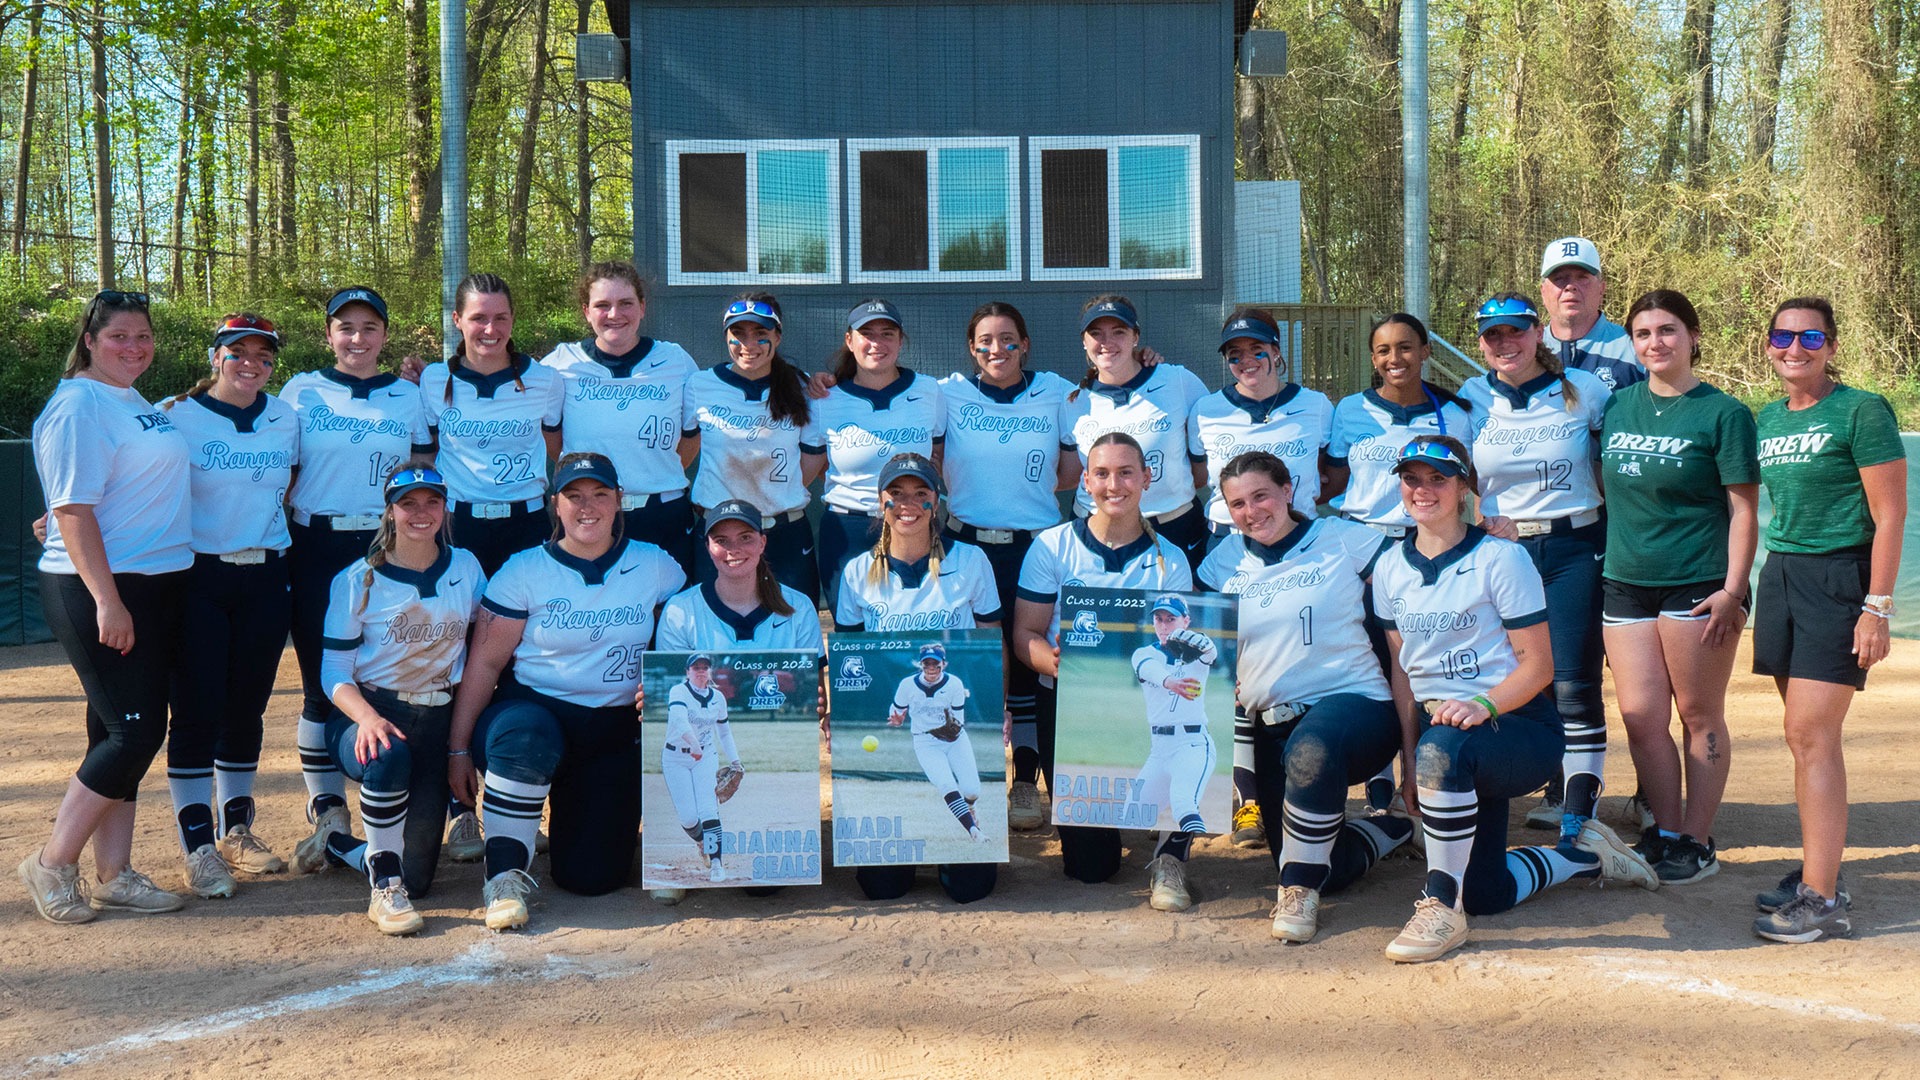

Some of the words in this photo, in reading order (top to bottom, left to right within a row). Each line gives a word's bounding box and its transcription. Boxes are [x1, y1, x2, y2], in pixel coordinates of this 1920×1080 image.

[1562, 241, 1579, 258] D
[575, 376, 670, 411] Rangers
[134, 411, 171, 431] DRE
[305, 404, 408, 444] Rangers
[438, 407, 534, 448] Rangers
[638, 415, 675, 450] 48
[957, 403, 1052, 443] Rangers
[1474, 416, 1575, 456] Rangers
[837, 422, 928, 457] Rangers
[1606, 432, 1693, 455] DREW
[1757, 432, 1833, 460] DREW
[493, 453, 535, 486] 22
[769, 448, 788, 482] 2
[1025, 450, 1045, 482] 8
[1535, 459, 1572, 492] 12
[1114, 598, 1146, 608] 2023
[1229, 568, 1325, 608] Rangers
[380, 612, 468, 646] Ranger
[541, 597, 646, 642] Rangers
[1299, 605, 1312, 646] 1
[1392, 598, 1477, 646] Rangers
[880, 640, 911, 650] 2023
[1067, 633, 1103, 643] DREW
[603, 643, 646, 682] 25
[781, 660, 814, 670] 2023
[1440, 648, 1480, 680] 18
[836, 679, 871, 688] DREW
[749, 697, 785, 706] DREW
[1055, 774, 1145, 801] BAILEY
[835, 816, 902, 839] MADI
[1056, 800, 1158, 827] COMEAU
[703, 829, 820, 855] BRIANNA
[838, 839, 926, 864] PRECHT
[752, 854, 820, 880] SEALS
